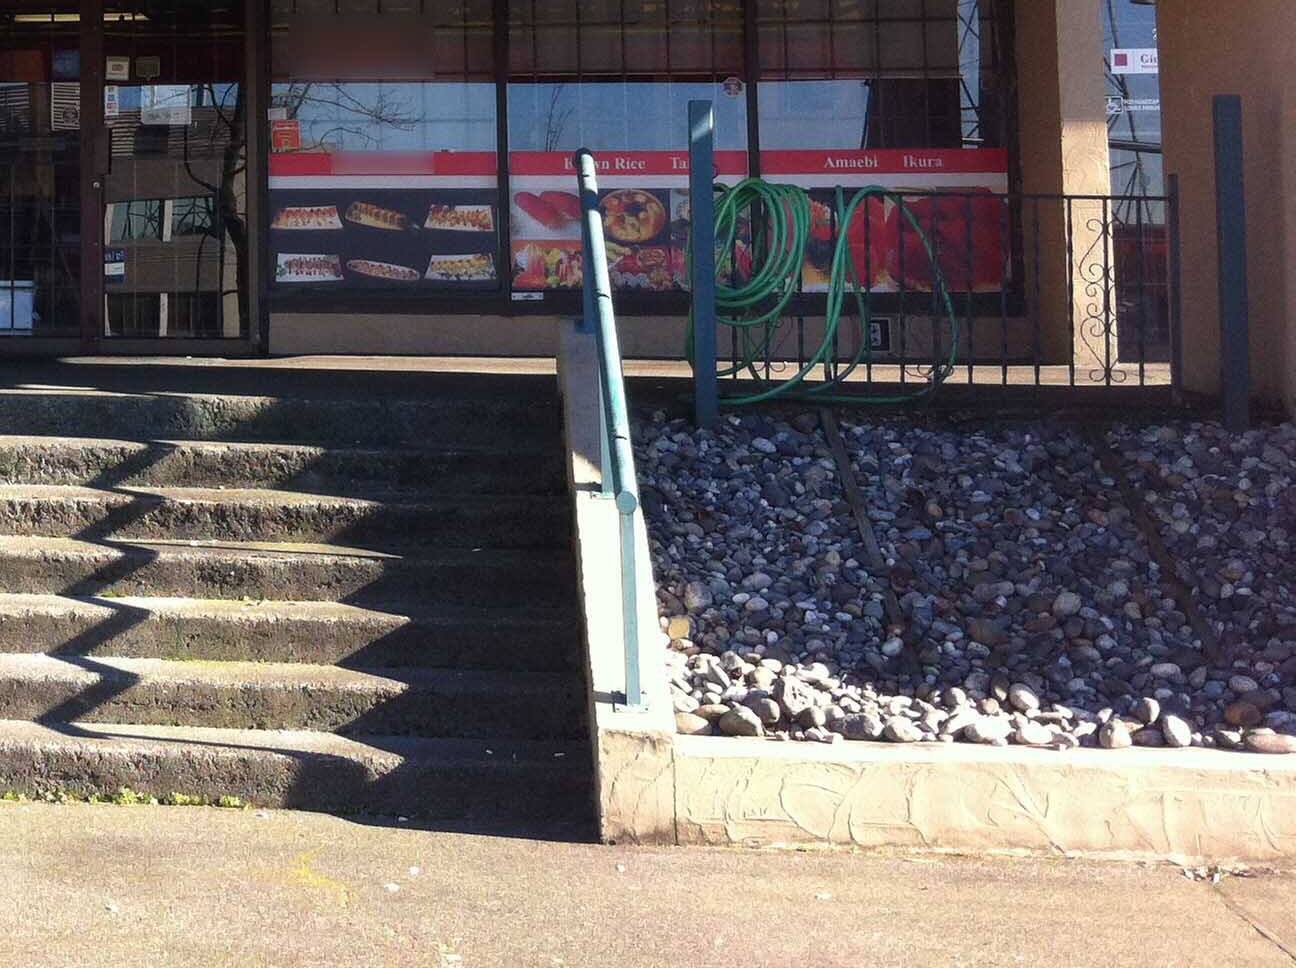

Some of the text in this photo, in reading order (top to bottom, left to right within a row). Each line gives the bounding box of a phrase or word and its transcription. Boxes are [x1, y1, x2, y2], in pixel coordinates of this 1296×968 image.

[615, 158, 646, 169] Rice
[823, 155, 878, 168] Amaebi
[903, 154, 943, 168] Ikura
